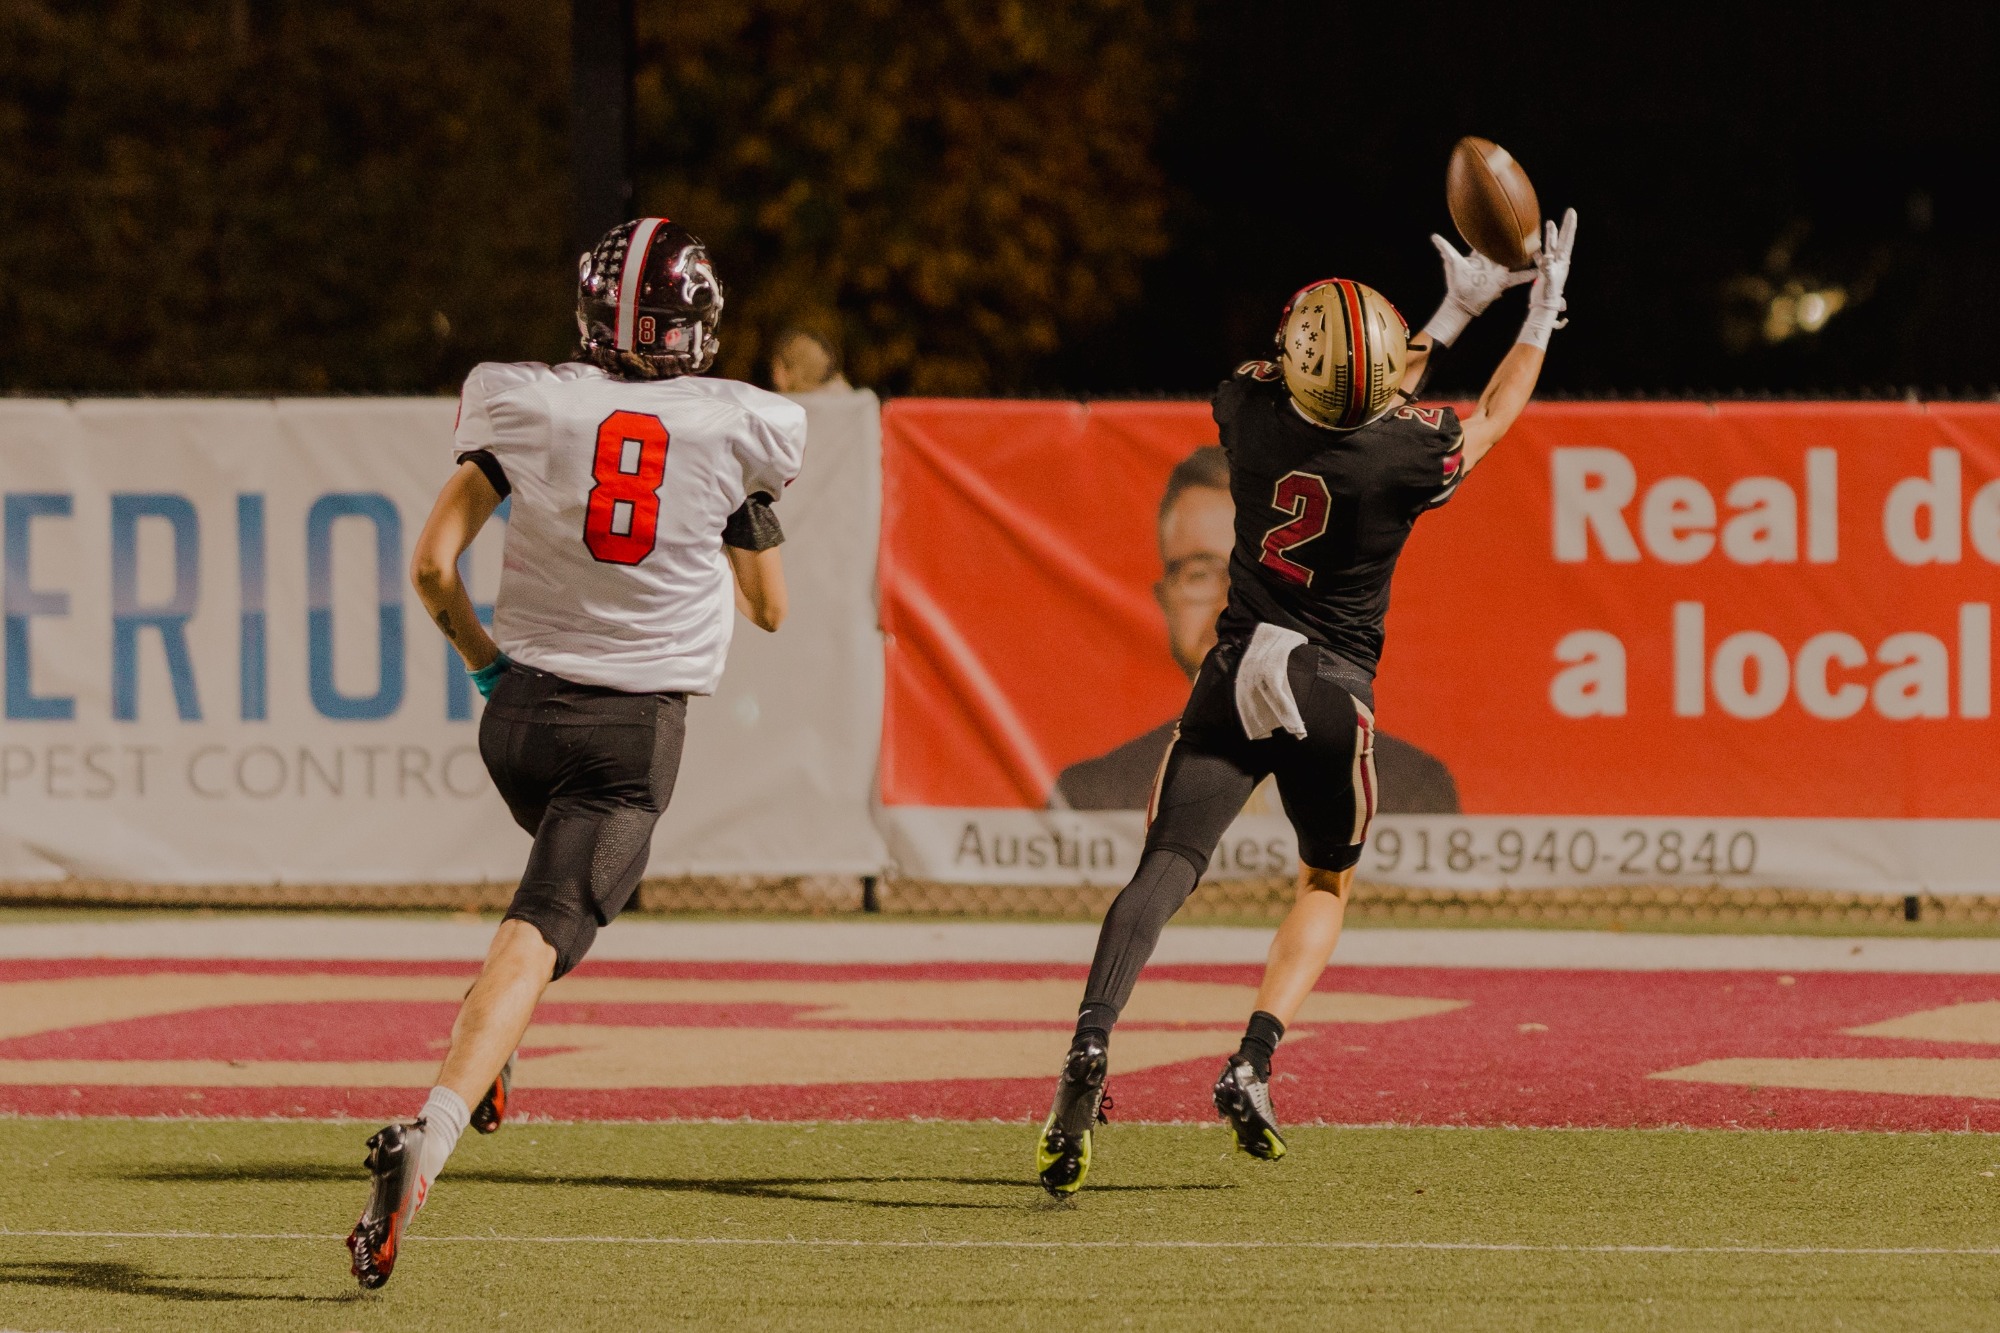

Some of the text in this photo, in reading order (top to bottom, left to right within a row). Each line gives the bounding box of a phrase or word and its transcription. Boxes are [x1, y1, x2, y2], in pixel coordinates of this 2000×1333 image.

[638, 315, 656, 344] 8
[582, 409, 670, 566] 8
[1258, 470, 1332, 588] 2
[1550, 446, 1840, 566] Real
[1549, 600, 1992, 721] a local
[2, 742, 163, 798] PEST
[954, 821, 1117, 870] Austin
[1373, 826, 1758, 876] 918-940-2840
